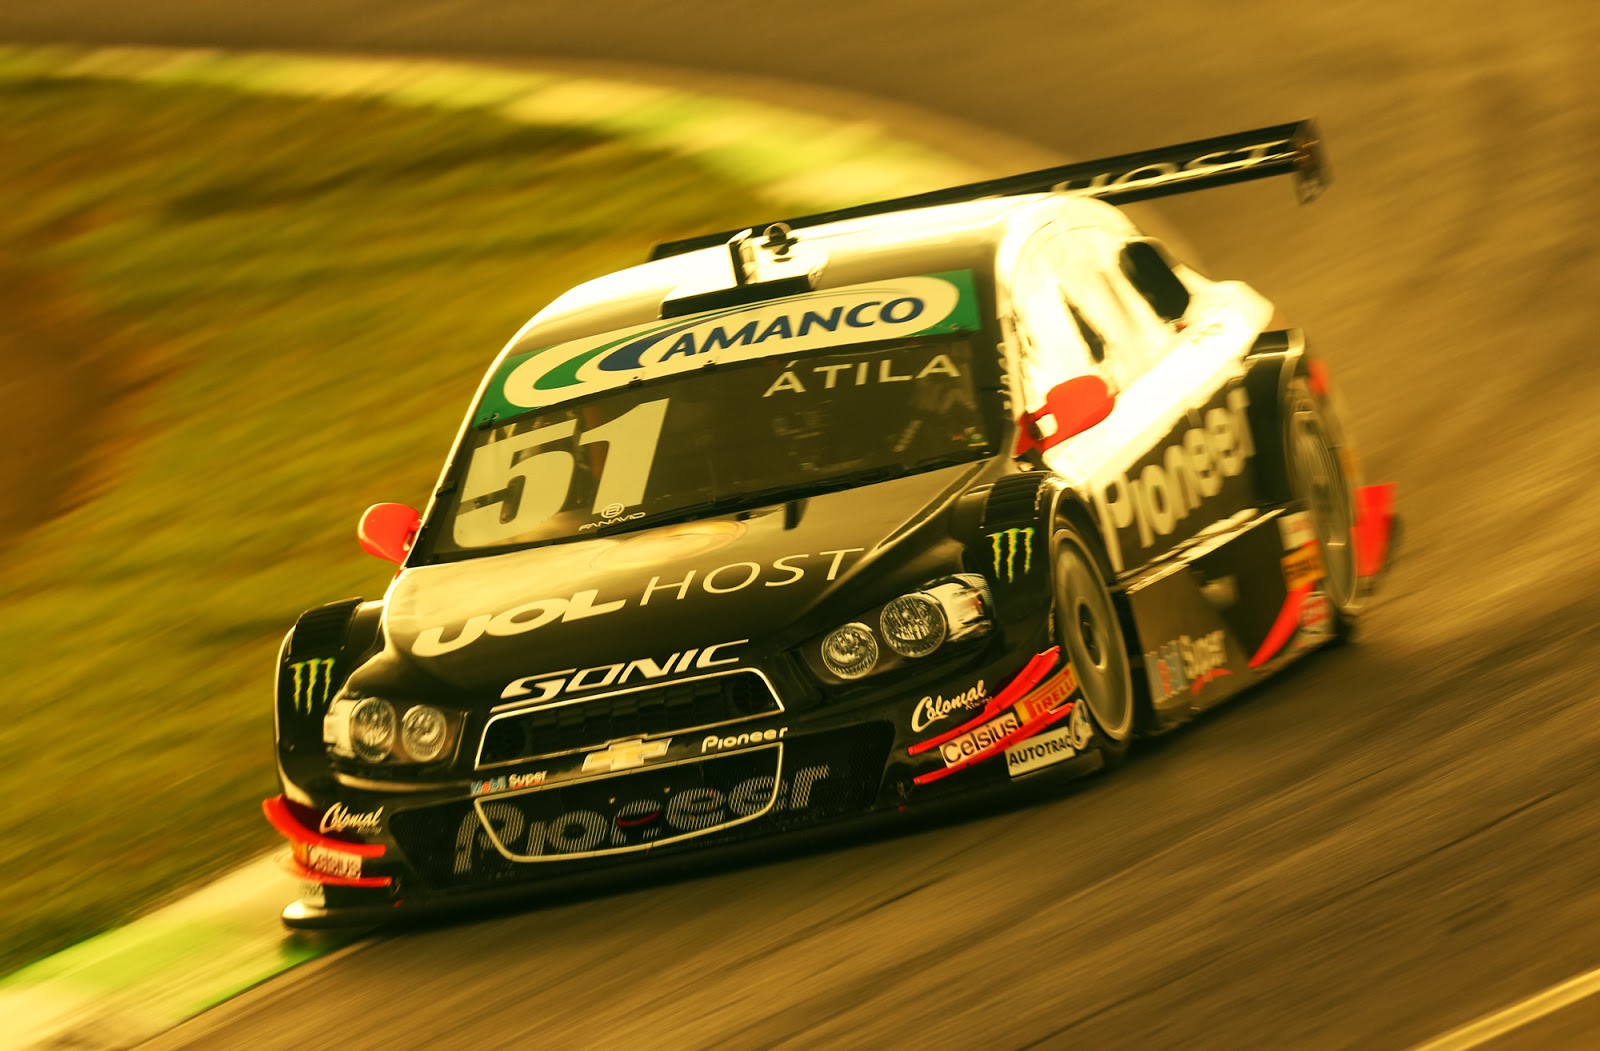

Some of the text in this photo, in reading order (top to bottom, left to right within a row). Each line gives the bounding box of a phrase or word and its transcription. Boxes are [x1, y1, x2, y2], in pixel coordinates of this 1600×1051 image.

[659, 297, 926, 363] AMANCO
[762, 353, 962, 398] ÁTILA
[453, 398, 670, 548] 51
[411, 547, 865, 658] UOL HOST
[500, 638, 750, 701] SONIC
[701, 726, 788, 753] Pioneer
[943, 717, 1018, 764] Celsius
[508, 770, 548, 788] Super
